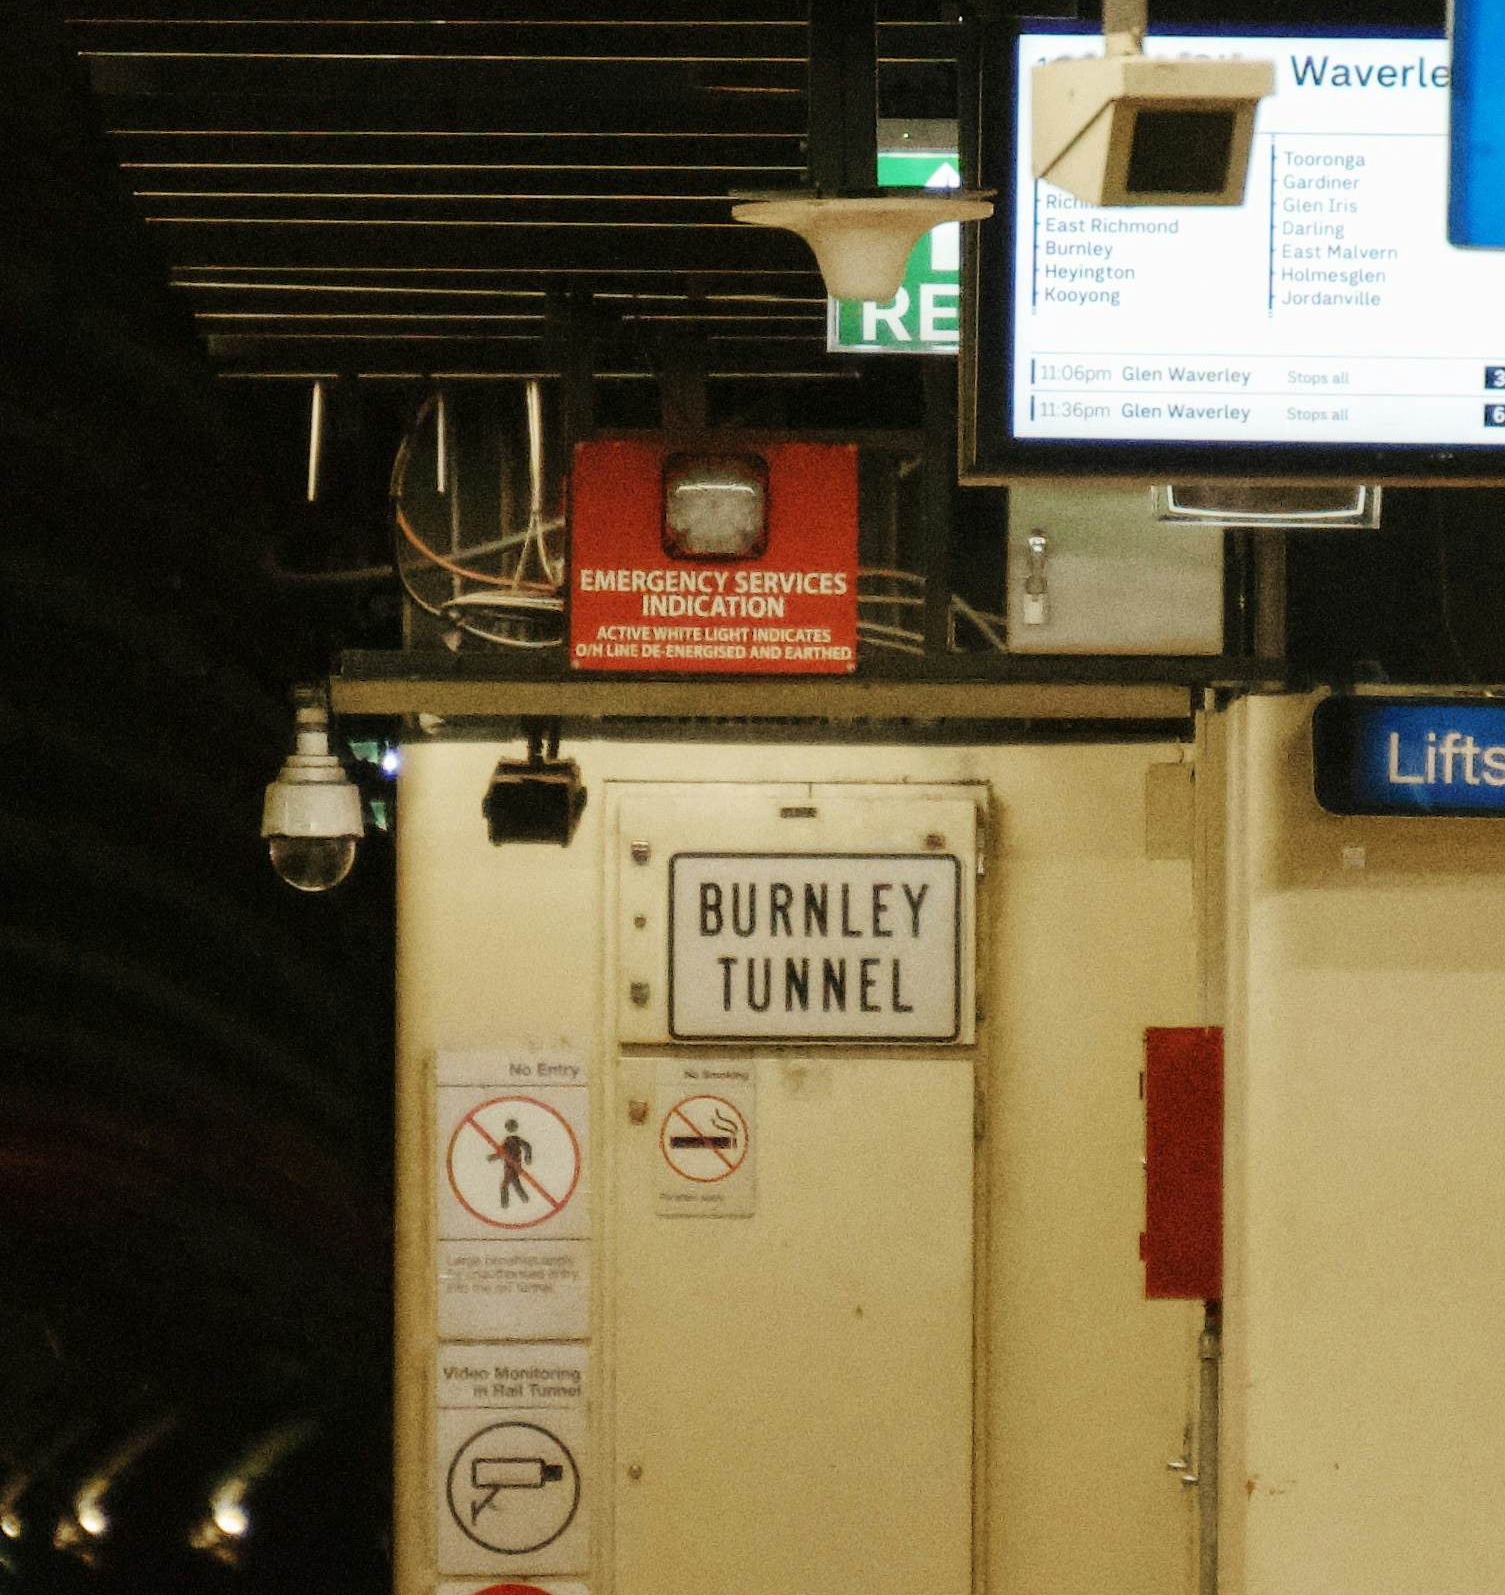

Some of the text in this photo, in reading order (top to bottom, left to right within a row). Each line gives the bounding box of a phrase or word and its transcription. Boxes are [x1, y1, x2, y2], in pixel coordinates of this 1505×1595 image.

[1290, 55, 1452, 88] Waverle
[1284, 151, 1366, 171] Tooronga
[1283, 175, 1360, 191] Gardiner
[1283, 198, 1358, 214] Glen Iris
[1045, 218, 1179, 235] East Richmond
[1282, 221, 1345, 241] Darling
[1045, 241, 1113, 259] Burnley
[1282, 245, 1399, 261] East Malvern
[1044, 264, 1135, 283] Heyington
[1281, 267, 1387, 287] Holmesglen
[1044, 287, 1120, 307] Kooyong
[1281, 291, 1382, 307] Jordanville
[1041, 364, 1112, 385] 11:06pm
[1121, 366, 1163, 383] Glen
[1168, 366, 1252, 387] Waverley
[1287, 370, 1328, 386] Stops
[1332, 370, 1350, 385] all
[1040, 401, 1111, 421] 11:36pm
[1121, 403, 1163, 420] Glen
[1168, 403, 1252, 424] Waverley
[1287, 407, 1328, 423] Stops
[1332, 407, 1350, 421] all
[580, 569, 848, 596] EMERGENCY SERVICES
[642, 594, 786, 618] INDICATION
[597, 625, 831, 644] ACTIVE WHITE LIGHT INDICATES
[575, 643, 852, 662] O/H LINE DE-ENERGISED AND EARTHED
[700, 881, 930, 938] BURNLEY
[717, 956, 914, 1013] TUNNEL
[509, 1062, 580, 1079] No Entry
[443, 1365, 581, 1383] Video Monitoring
[494, 1383, 523, 1398] Rail
[530, 1383, 581, 1397] Tunnel
